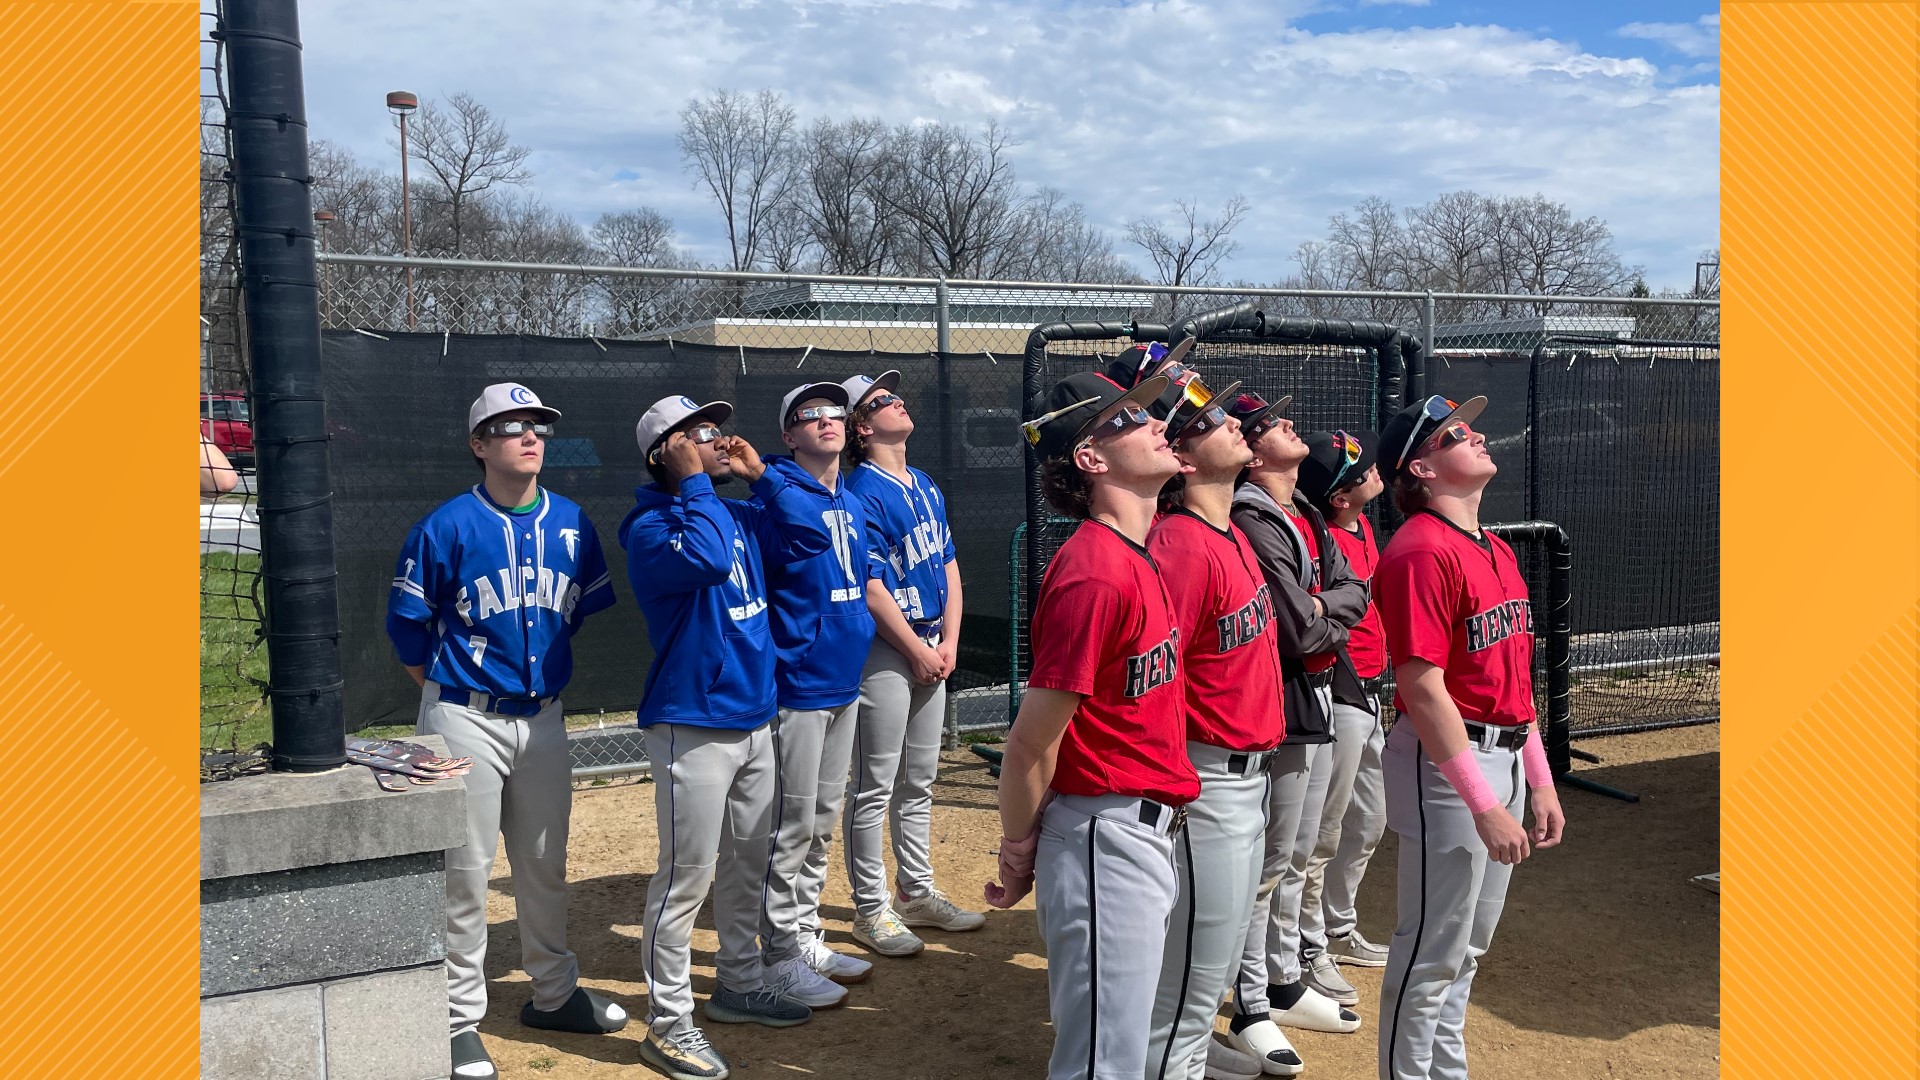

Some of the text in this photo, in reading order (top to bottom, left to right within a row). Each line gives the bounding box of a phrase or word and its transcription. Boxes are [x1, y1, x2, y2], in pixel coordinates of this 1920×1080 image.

[455, 565, 582, 627] FALCONS
[894, 586, 925, 621] 29
[468, 634, 488, 668] 7
